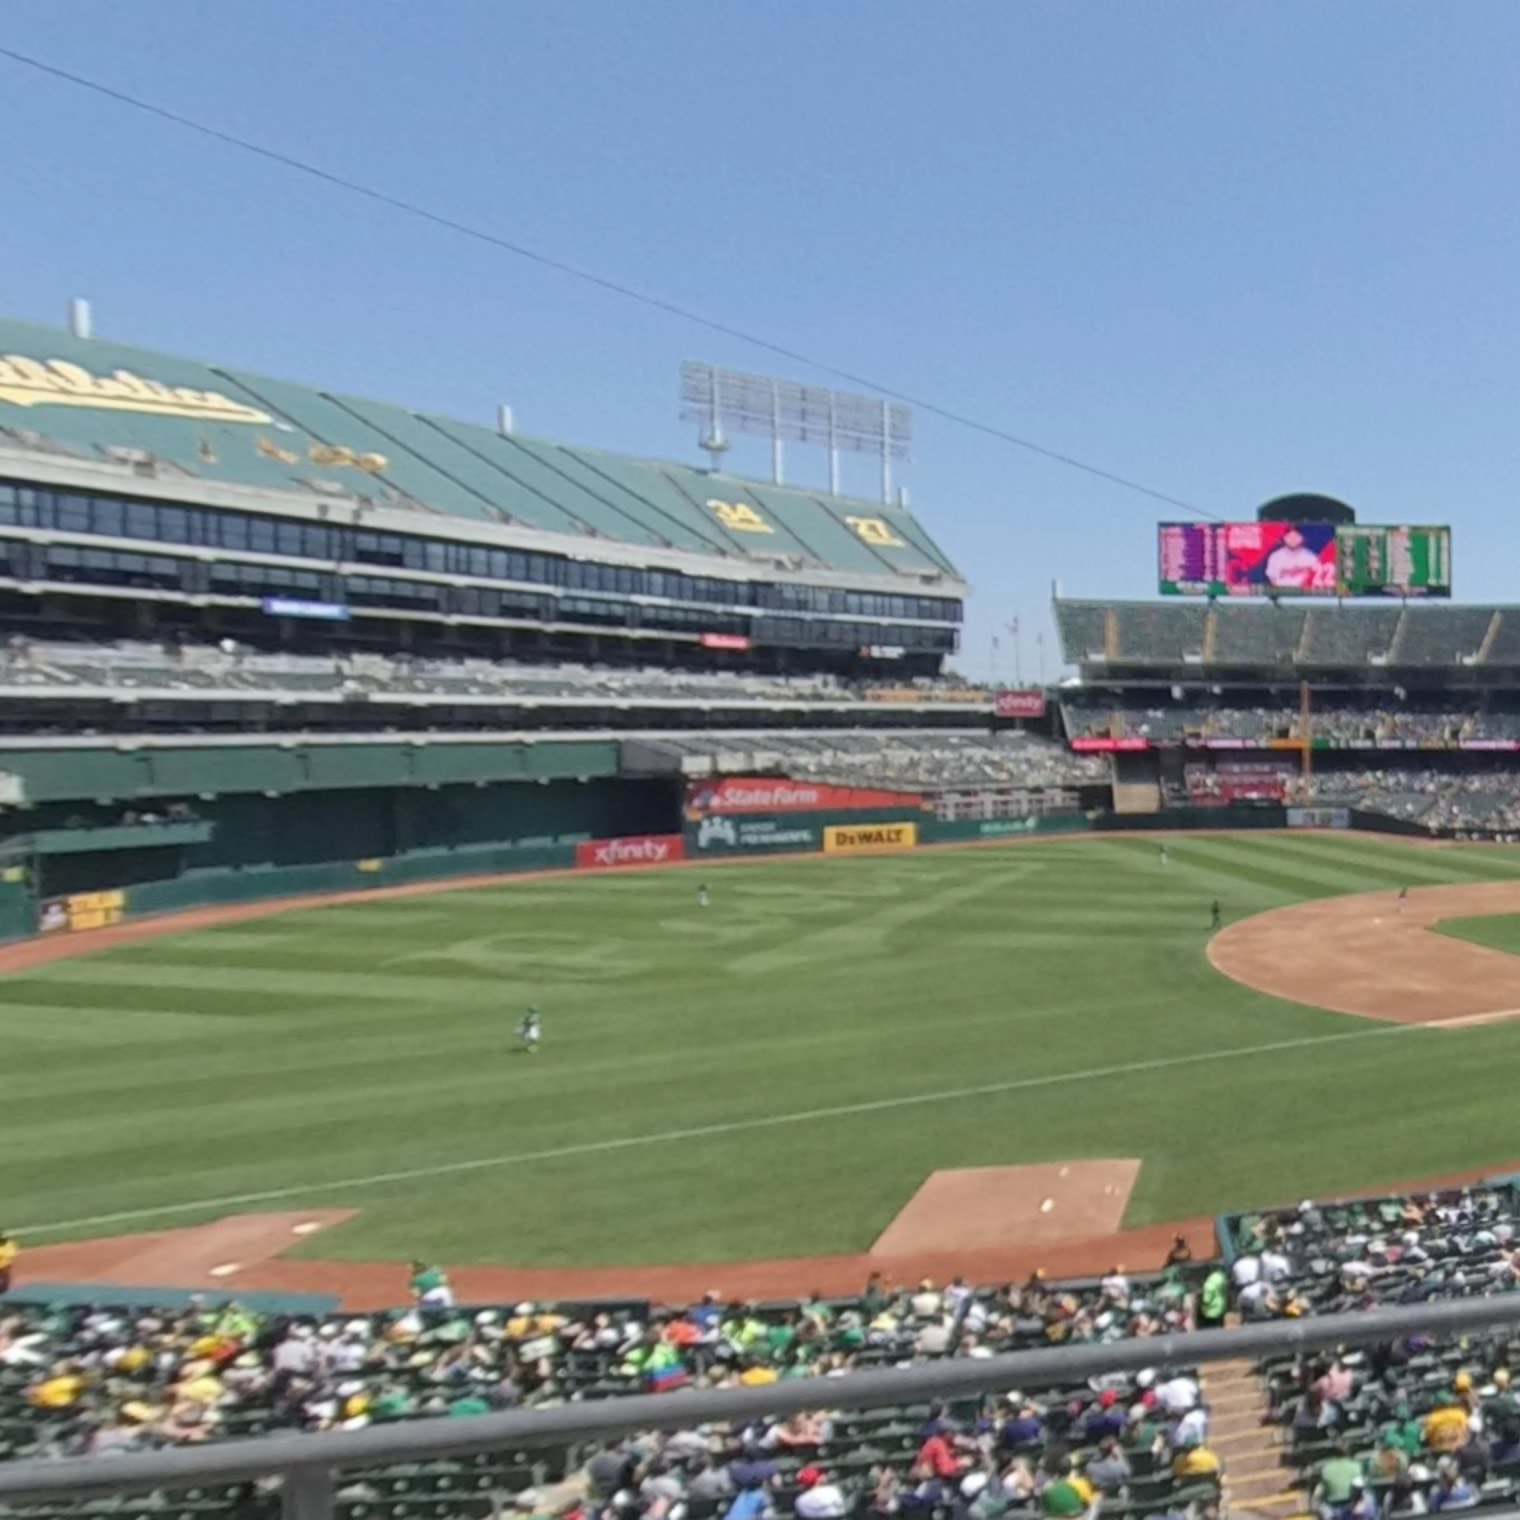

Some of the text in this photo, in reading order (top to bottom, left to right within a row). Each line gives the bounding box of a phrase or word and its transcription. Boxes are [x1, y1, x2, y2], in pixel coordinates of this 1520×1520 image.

[706, 499, 775, 534] 34
[845, 515, 905, 547] 27
[1311, 562, 1336, 588] 22
[998, 693, 1039, 709] xfinity
[594, 838, 667, 864] xfinity
